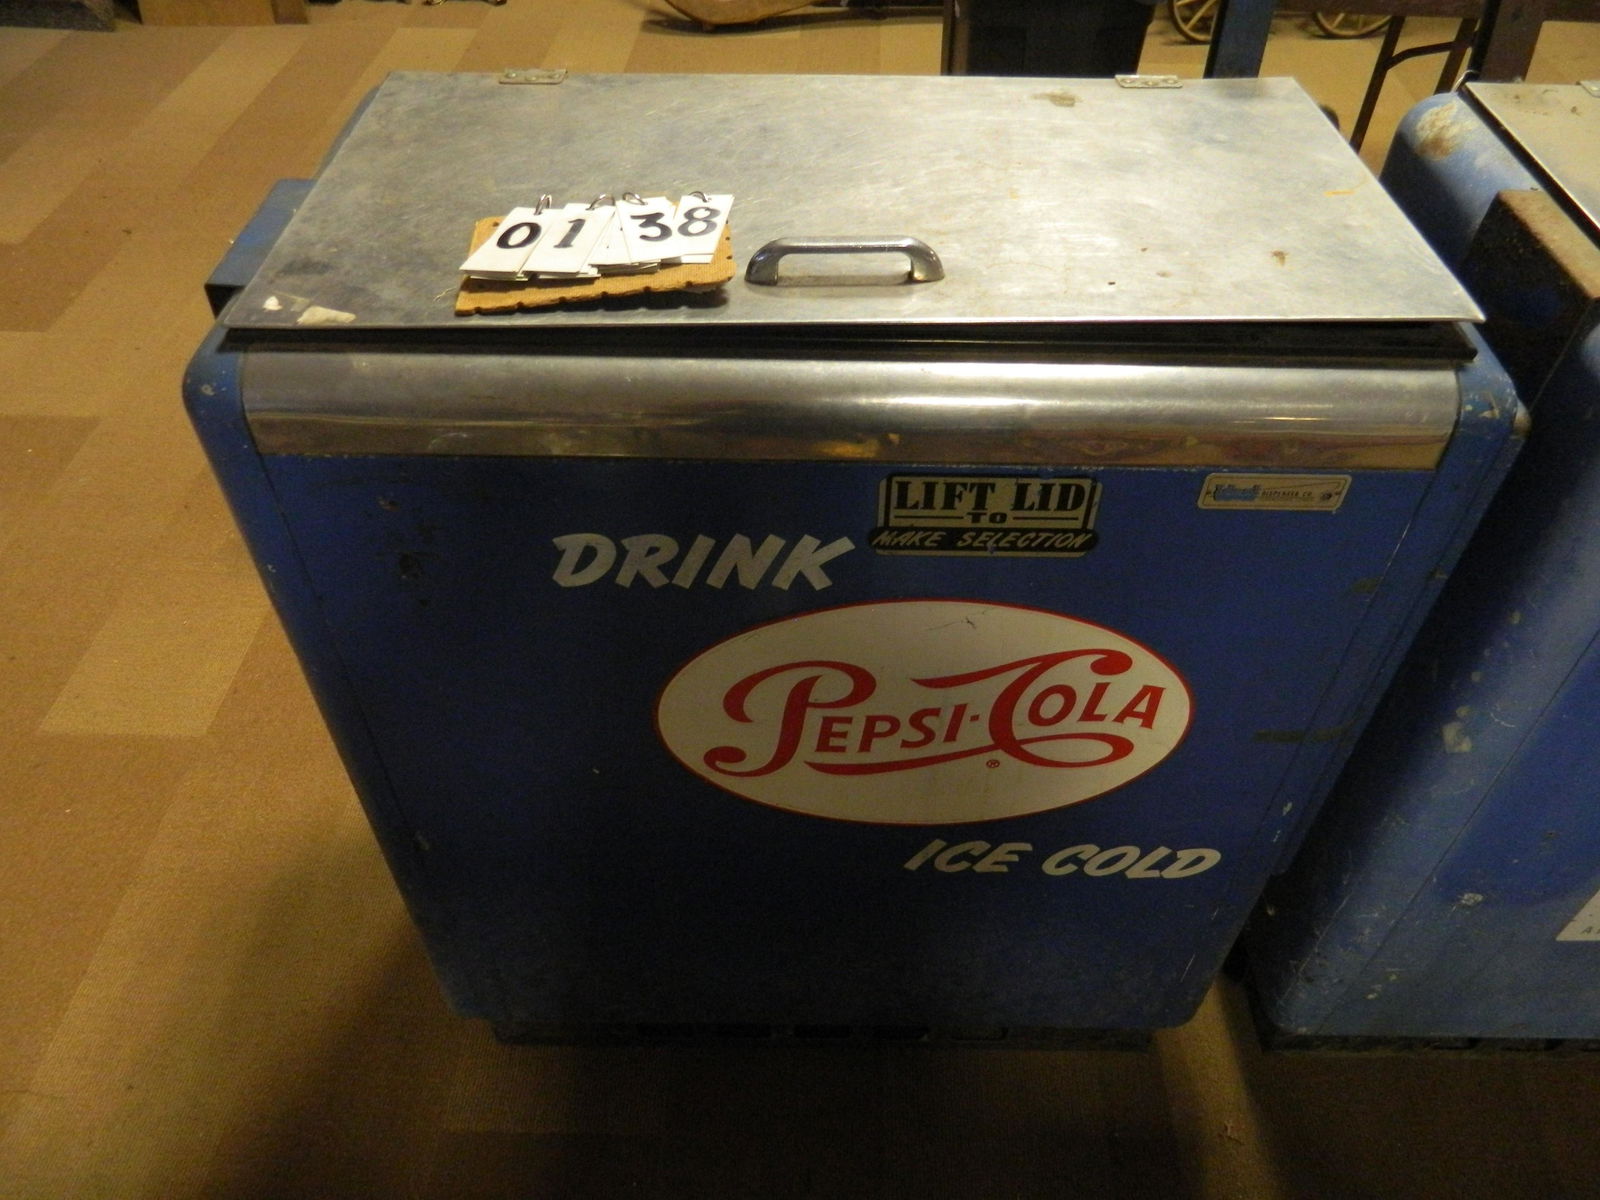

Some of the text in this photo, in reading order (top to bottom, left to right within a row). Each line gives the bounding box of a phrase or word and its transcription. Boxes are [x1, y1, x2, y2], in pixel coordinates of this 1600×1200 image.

[496, 206, 720, 249] 0138
[893, 480, 1086, 513] LIFT LID
[966, 512, 1008, 524] TO
[871, 529, 1093, 549] MAKE SELECTION
[551, 532, 856, 591] DRINK
[903, 838, 1222, 879] ICE COLD
